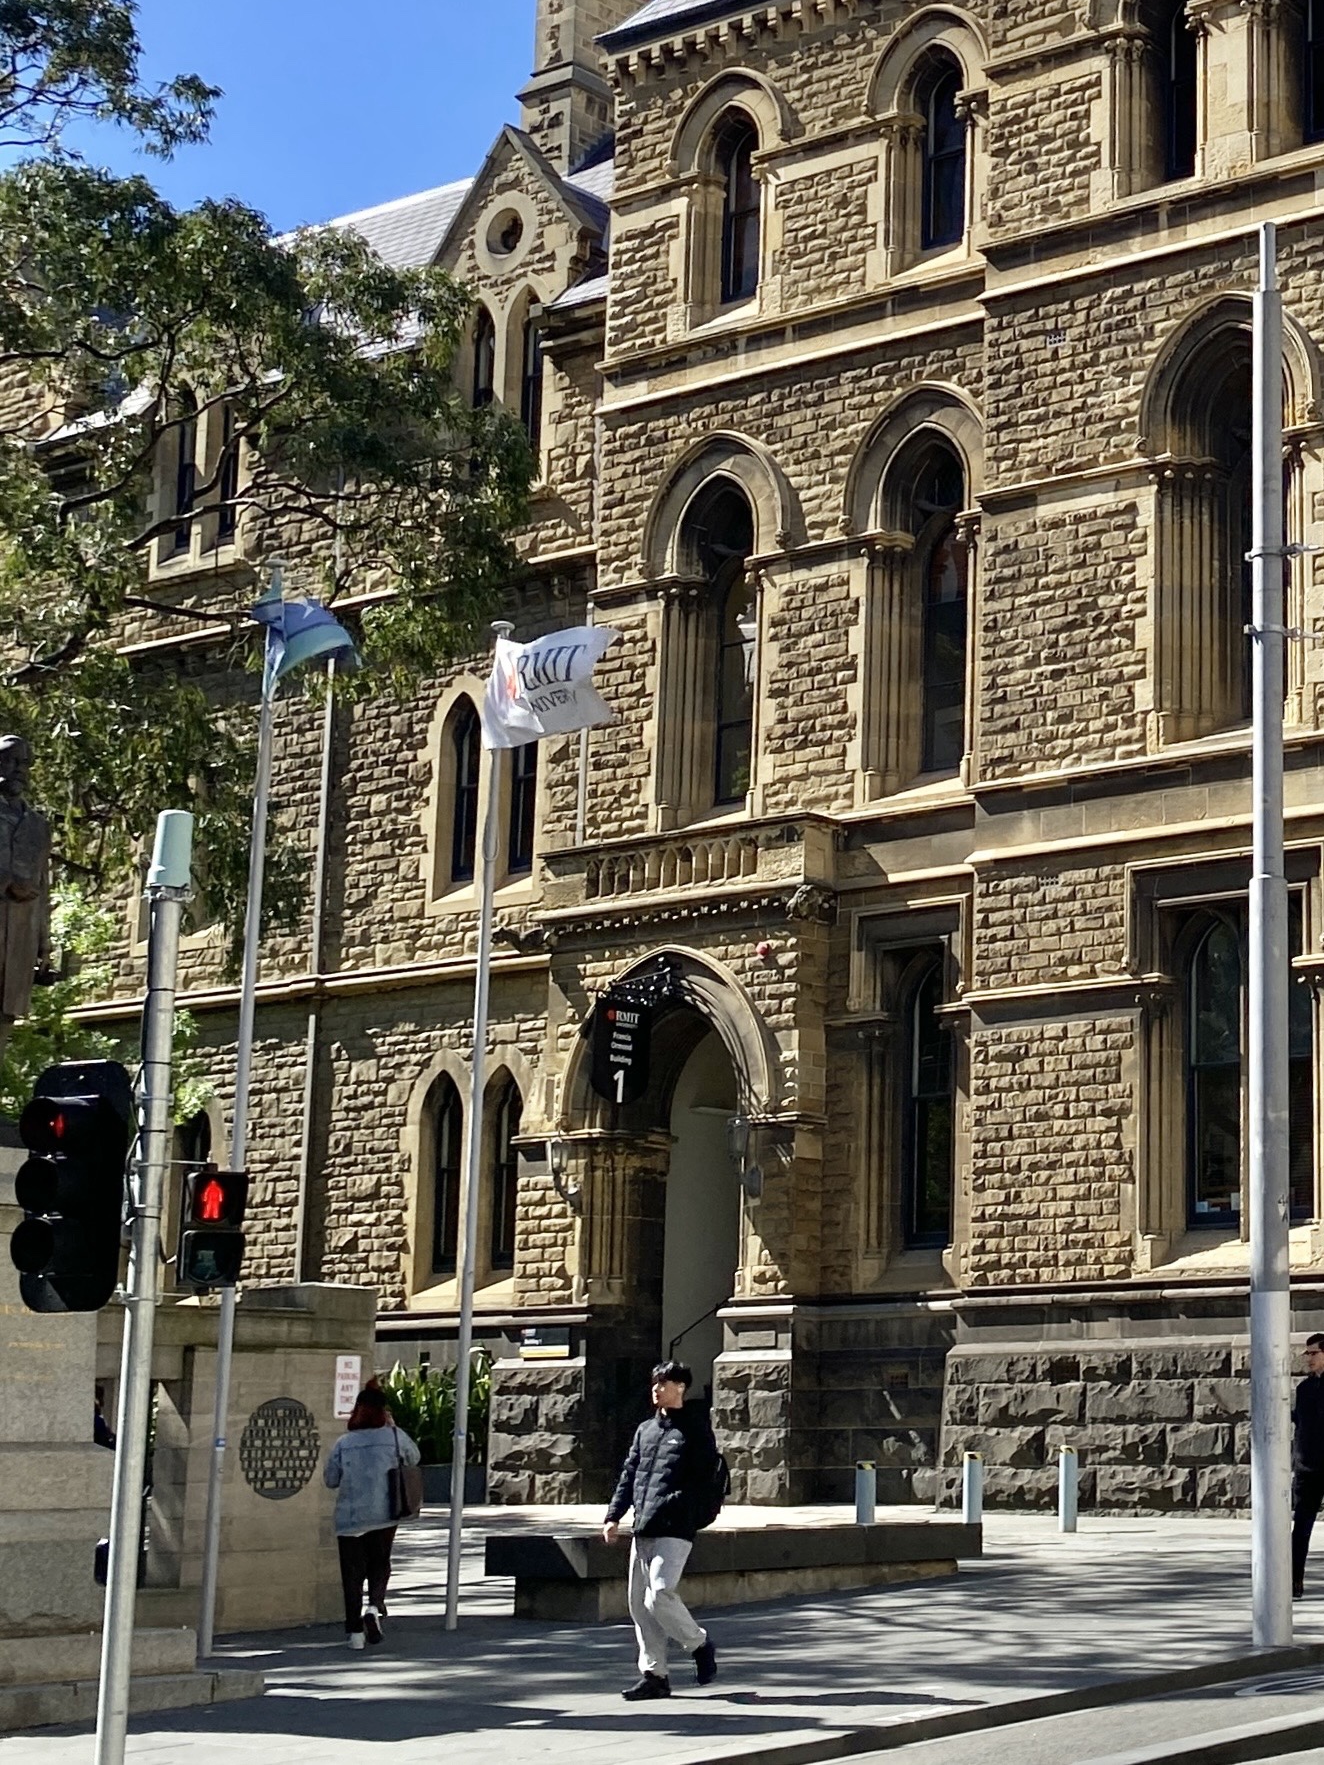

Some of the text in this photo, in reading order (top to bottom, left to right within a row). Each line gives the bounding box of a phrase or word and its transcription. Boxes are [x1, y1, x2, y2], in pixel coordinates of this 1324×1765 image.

[517, 644, 587, 691] RMIT
[616, 1010, 640, 1024] RMIT
[609, 1054, 632, 1066] Building
[613, 1070, 625, 1103] 1
[340, 1384, 353, 1392] ANY
